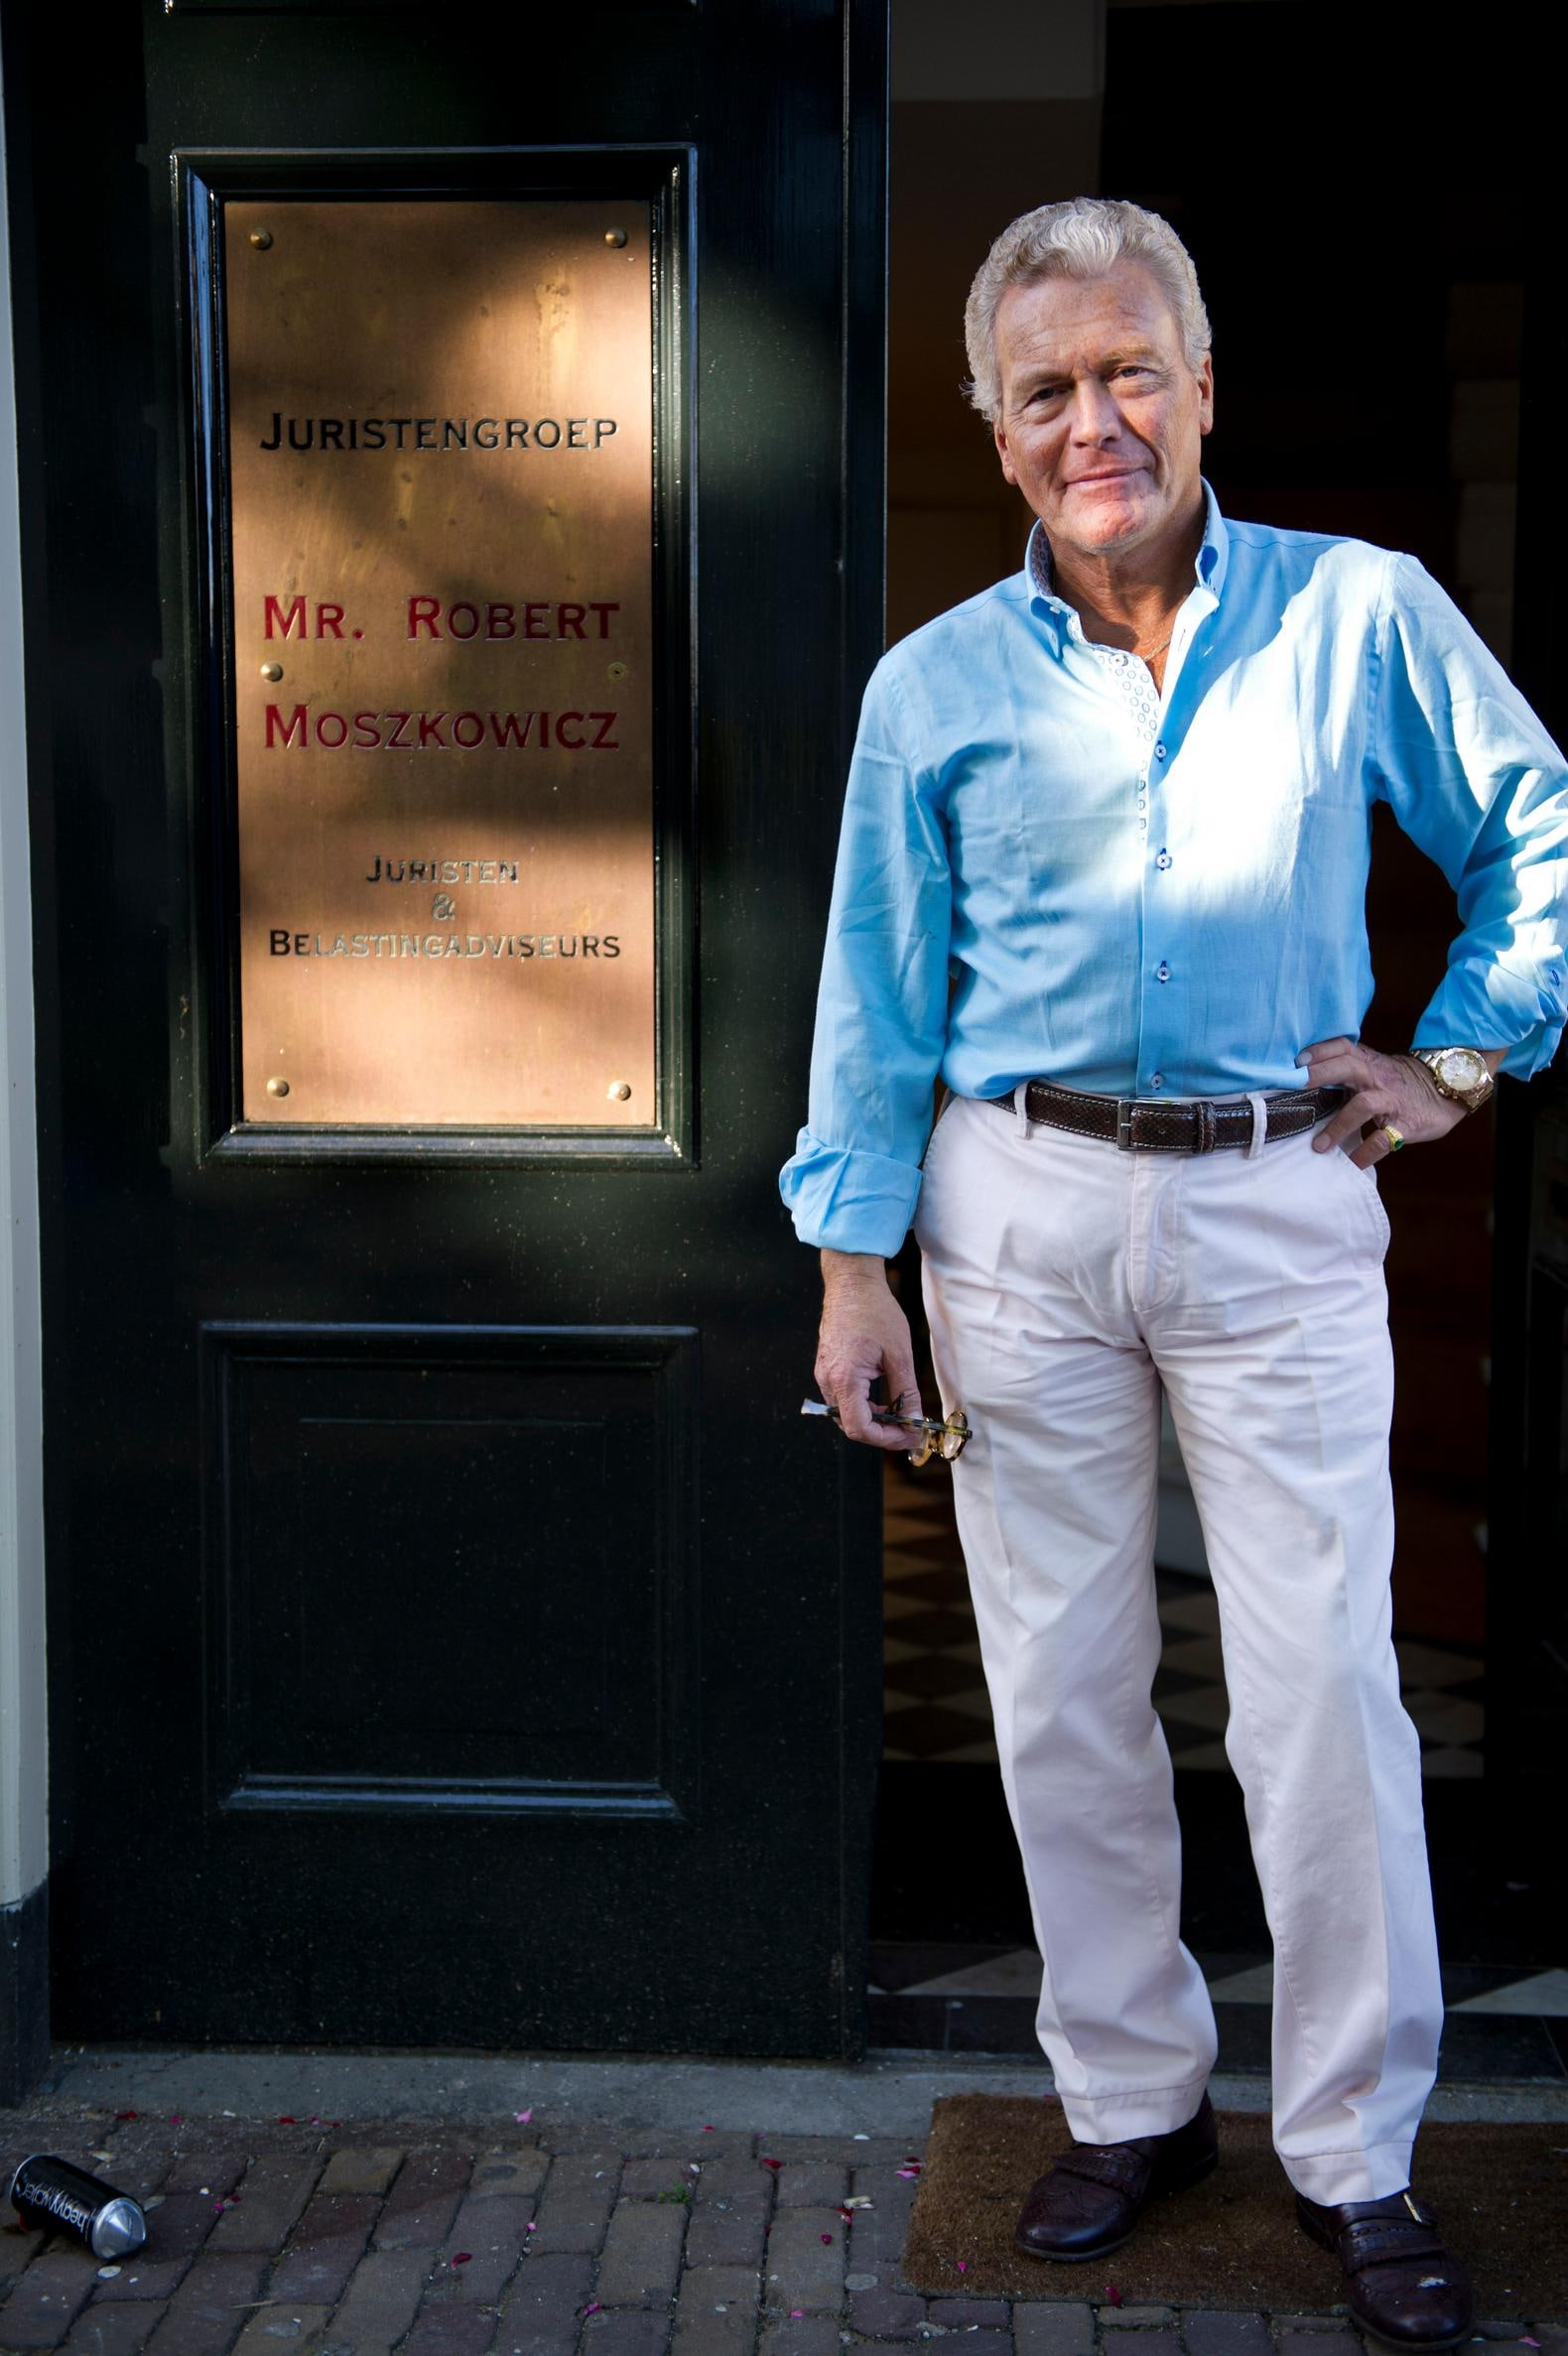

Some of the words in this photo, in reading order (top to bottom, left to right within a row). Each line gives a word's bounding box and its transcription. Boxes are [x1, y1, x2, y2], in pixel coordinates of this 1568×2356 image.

[406, 595, 621, 642] ROBERT
[264, 703, 620, 750] MOSZKOWICZ
[365, 854, 522, 884] JURISTEN
[431, 893, 456, 921] &
[269, 929, 621, 960] BELASTINGADVISEURS
